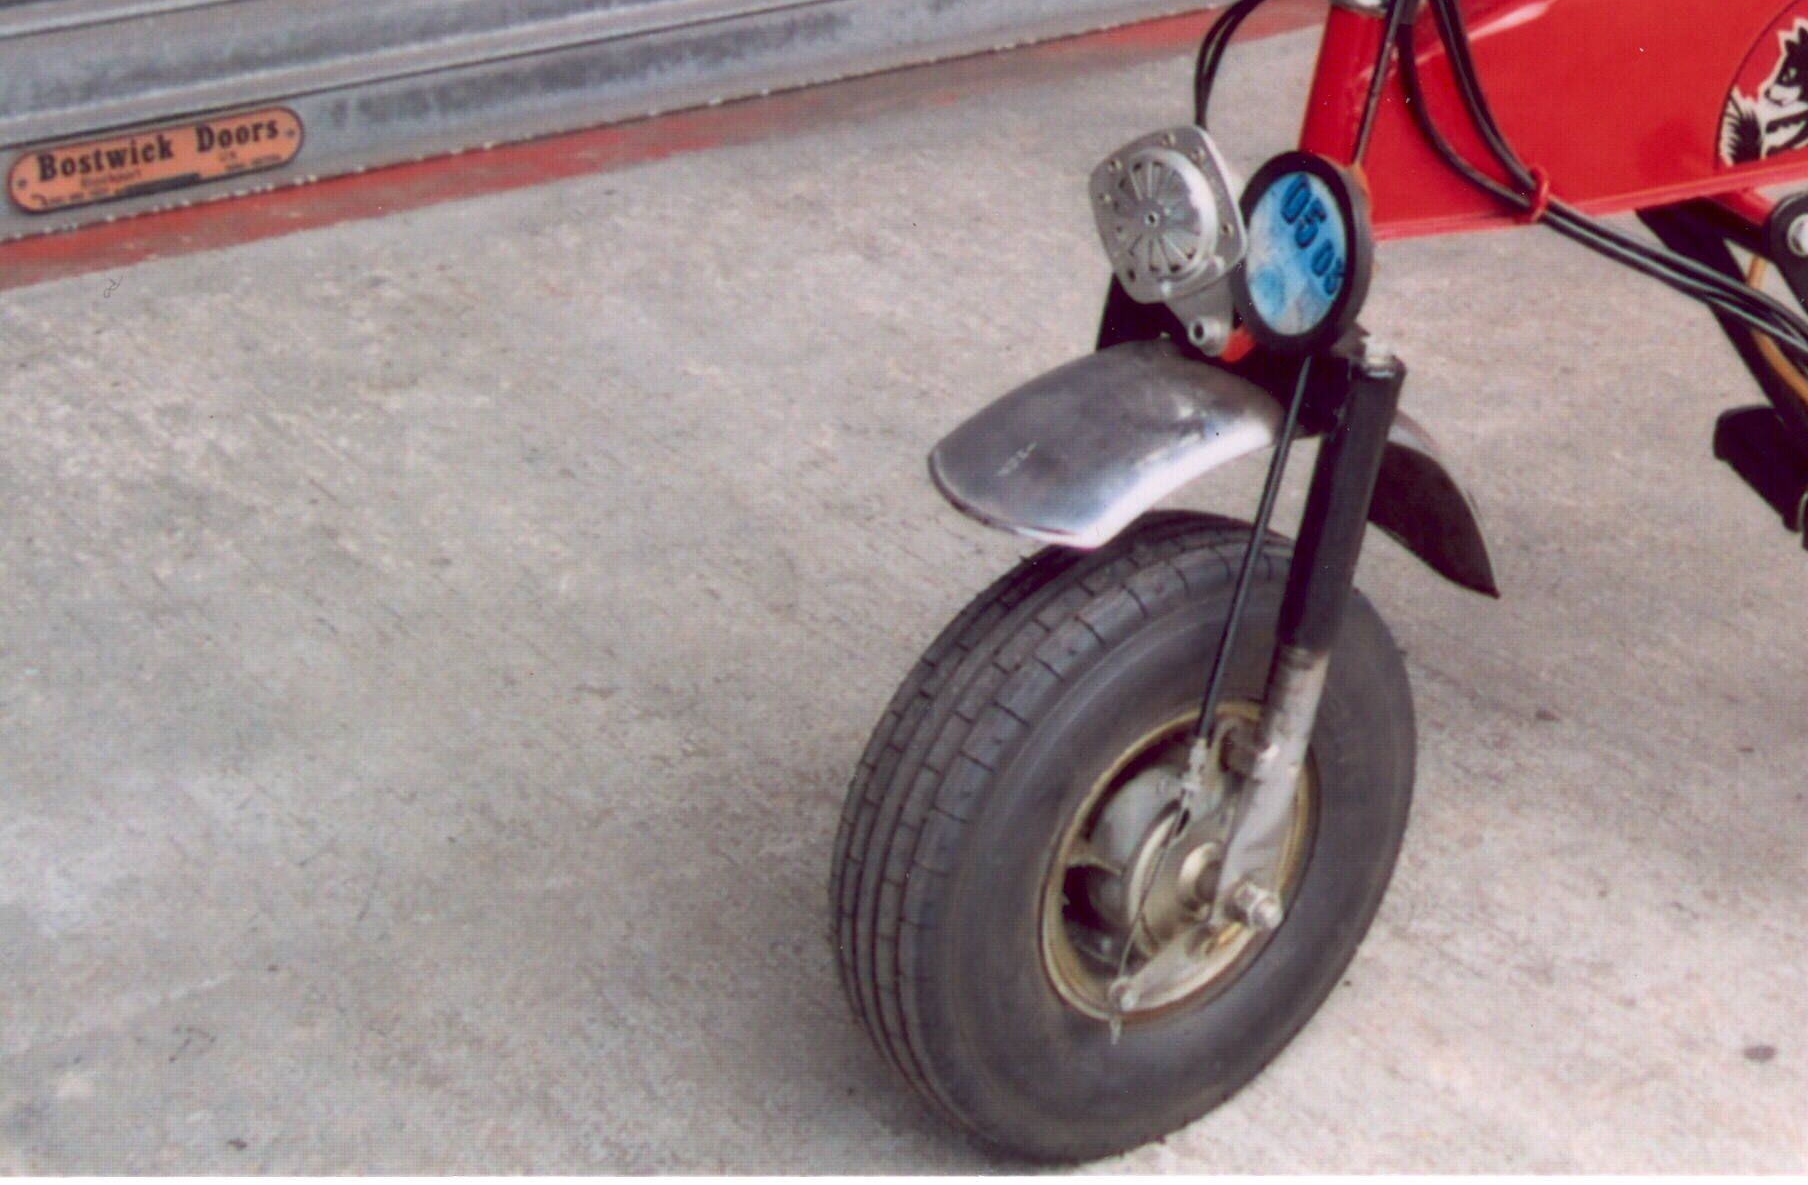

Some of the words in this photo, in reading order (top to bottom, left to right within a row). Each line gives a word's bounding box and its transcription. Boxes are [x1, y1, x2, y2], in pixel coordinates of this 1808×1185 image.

[36, 133, 174, 182] Bostwick
[194, 118, 280, 154] Doors
[1281, 173, 1328, 250] 05
